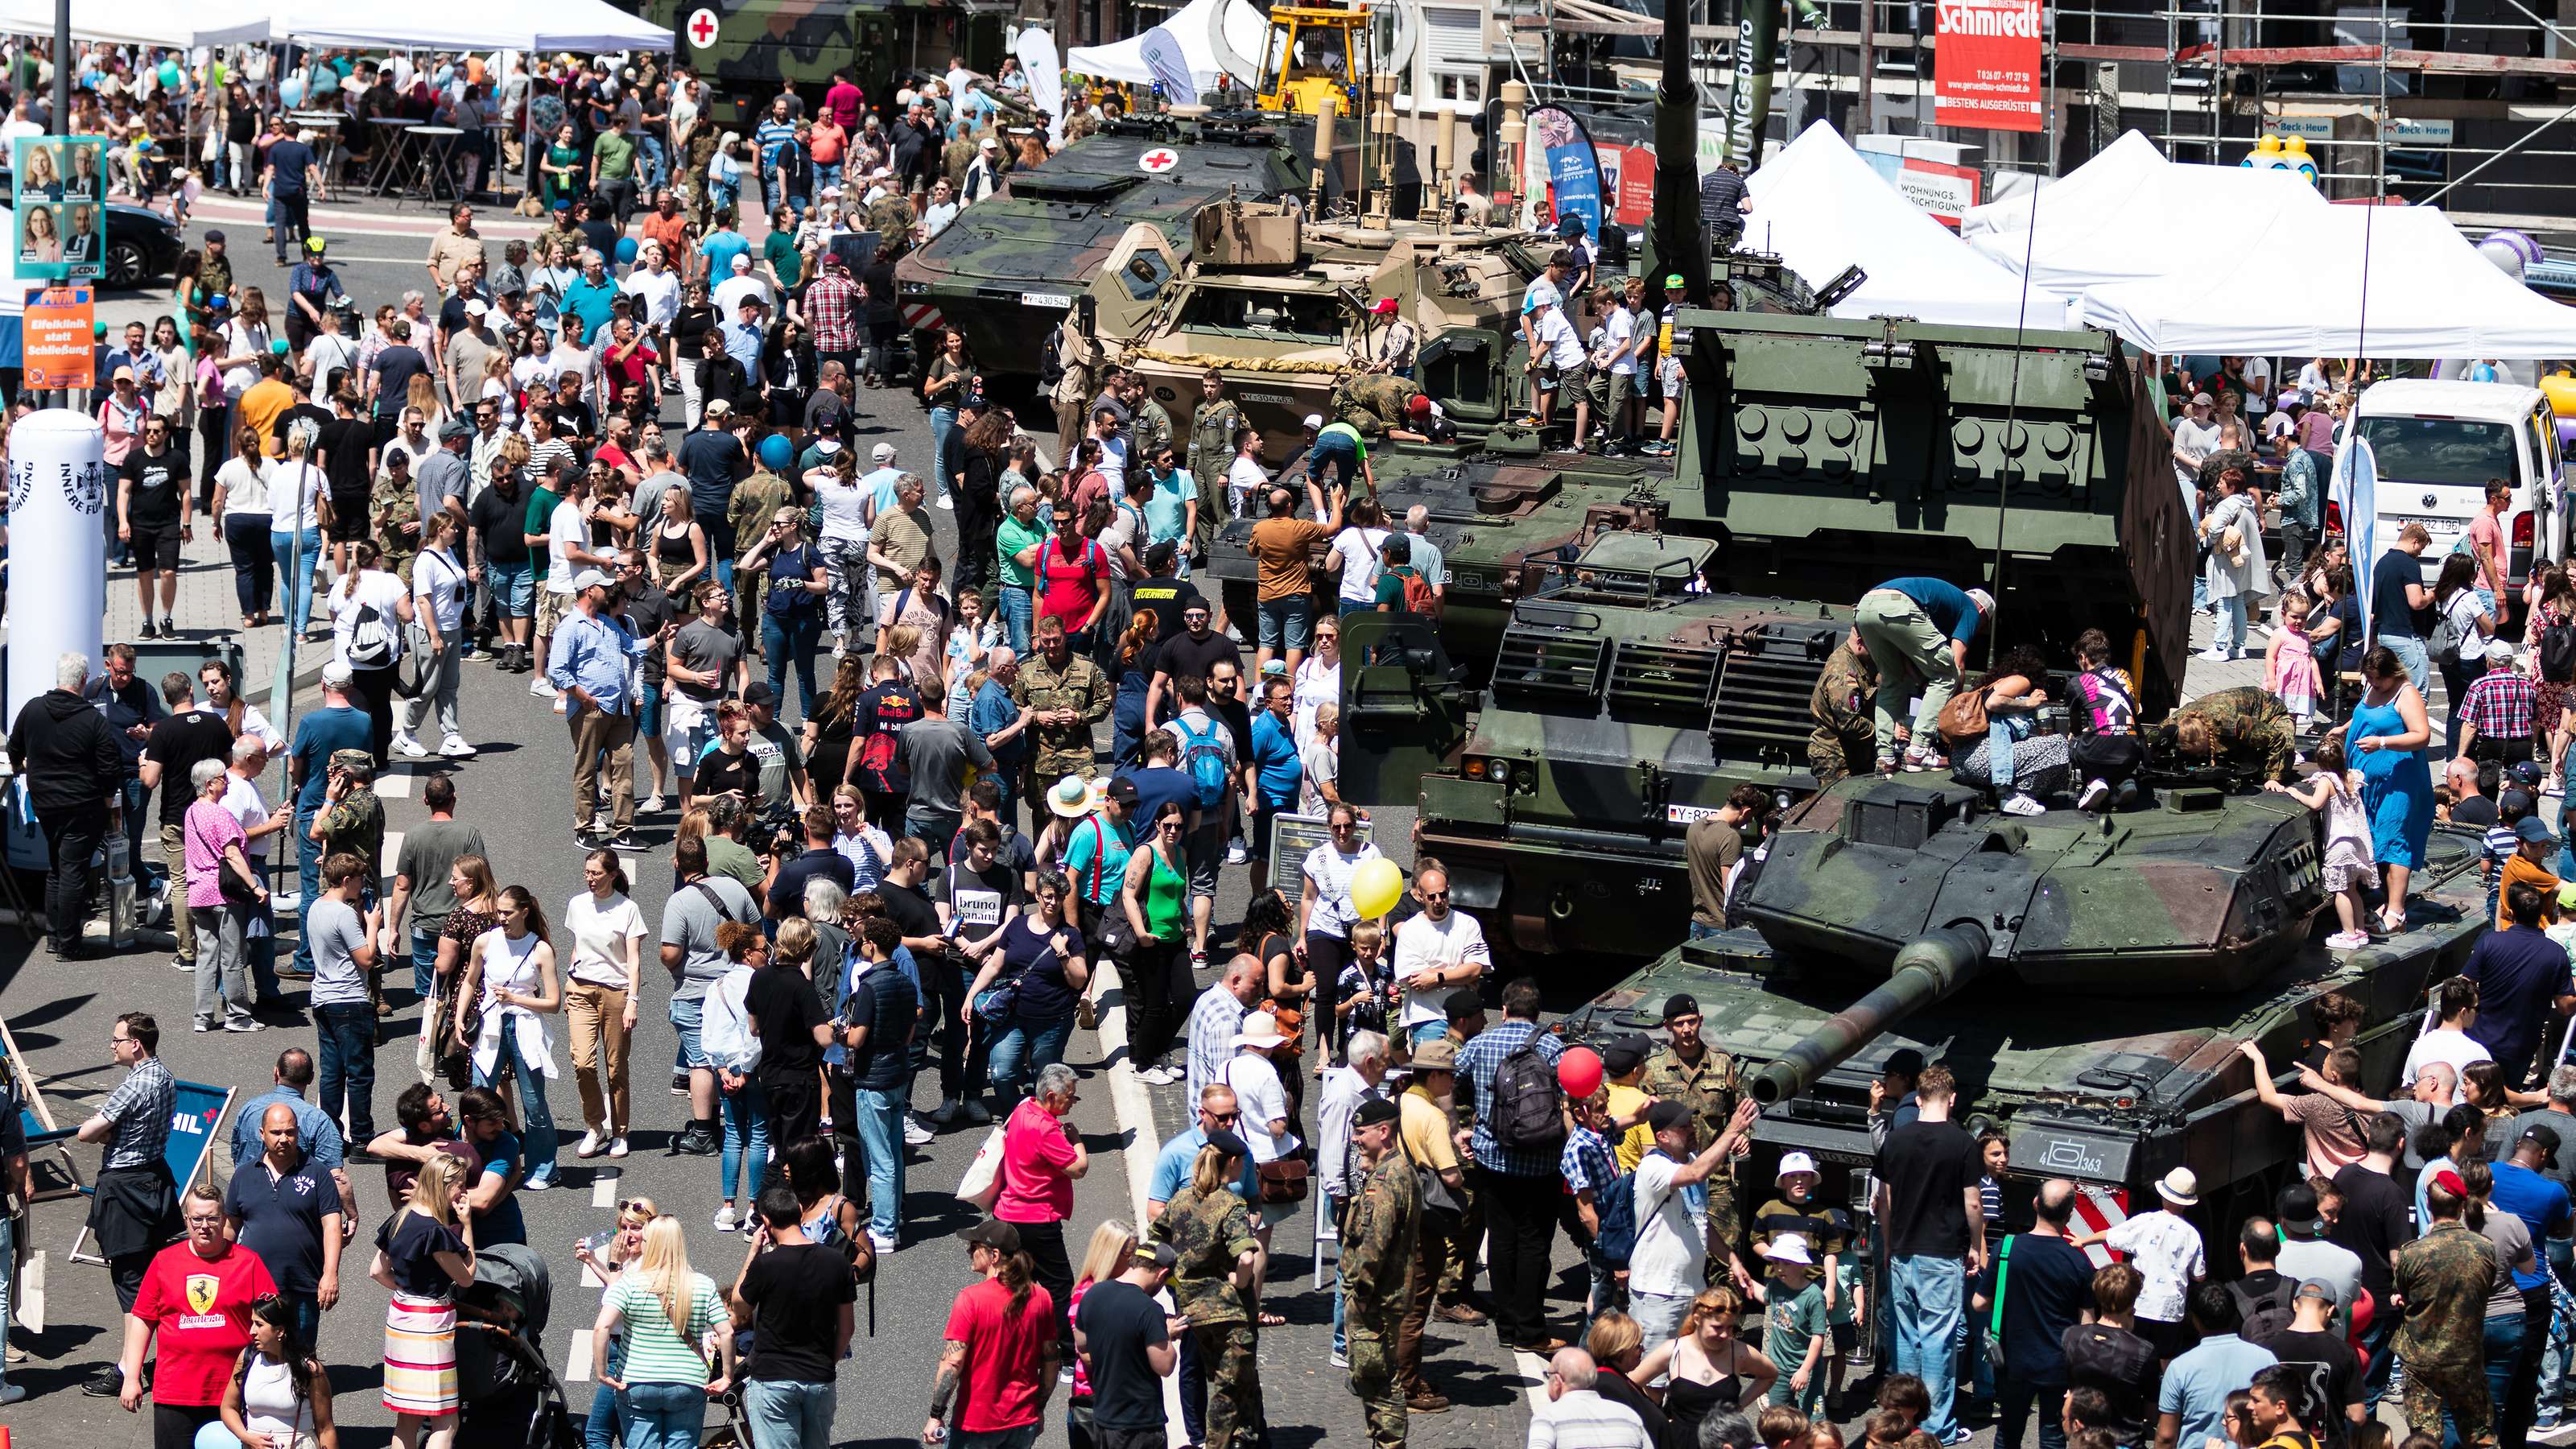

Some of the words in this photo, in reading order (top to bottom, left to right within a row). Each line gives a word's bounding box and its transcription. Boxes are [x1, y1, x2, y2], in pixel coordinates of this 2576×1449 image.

[1938, 0, 2040, 38] Schmiedt
[1947, 97, 1979, 109] BESTENS
[1979, 99, 2030, 112] AUSGERÜSTET
[77, 266, 98, 275] CDU
[44, 332, 72, 341] statt
[27, 344, 89, 356] Schließung
[60, 463, 85, 512] INNERE
[2440, 520, 2458, 530] 196
[1133, 588, 1178, 600] FEUERWEHR
[906, 610, 919, 620] VON
[877, 707, 894, 716] Red
[895, 708, 913, 718] Bull
[960, 896, 996, 910] bruno
[959, 909, 995, 921] banani
[2038, 1151, 2047, 1165] 4
[2081, 1157, 2102, 1172] 363
[295, 1182, 311, 1196] 37
